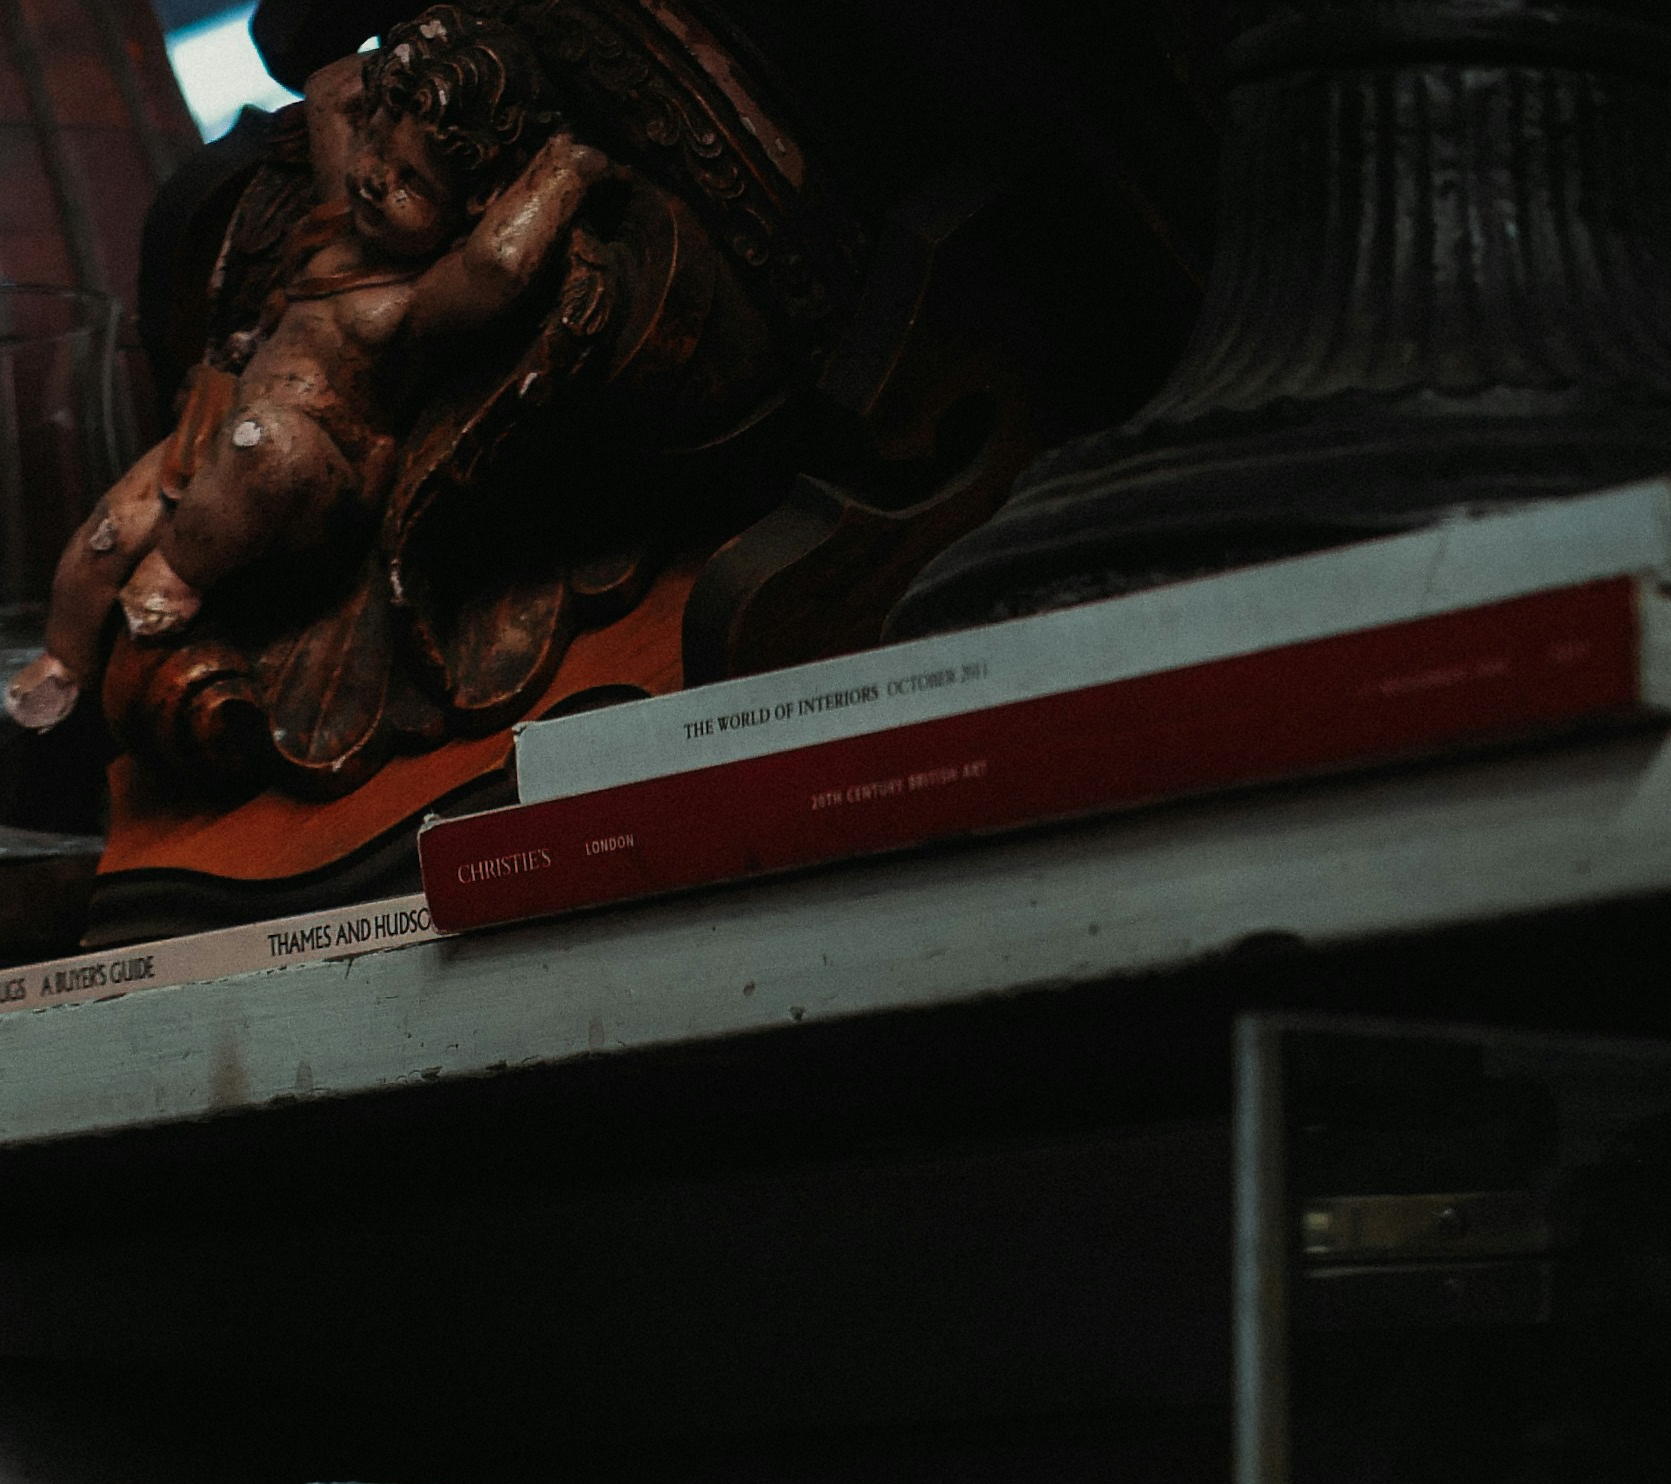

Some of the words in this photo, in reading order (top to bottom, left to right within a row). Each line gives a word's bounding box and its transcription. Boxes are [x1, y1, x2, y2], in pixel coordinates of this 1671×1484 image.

[683, 719, 714, 740] THE
[716, 708, 771, 733] WORLD
[774, 702, 794, 721] OF
[798, 685, 879, 718] INTERIORS
[886, 669, 957, 698] OCTOBER
[457, 848, 552, 885] CHRISTIE'S
[584, 833, 635, 857] LONDON
[846, 777, 904, 805] CENTURY
[40, 974, 53, 997] A
[54, 964, 108, 993] BUYER'S
[109, 955, 155, 984] GUIDE
[268, 925, 331, 957] THAMES
[335, 917, 372, 946] AND
[374, 906, 430, 938] HUDSO
